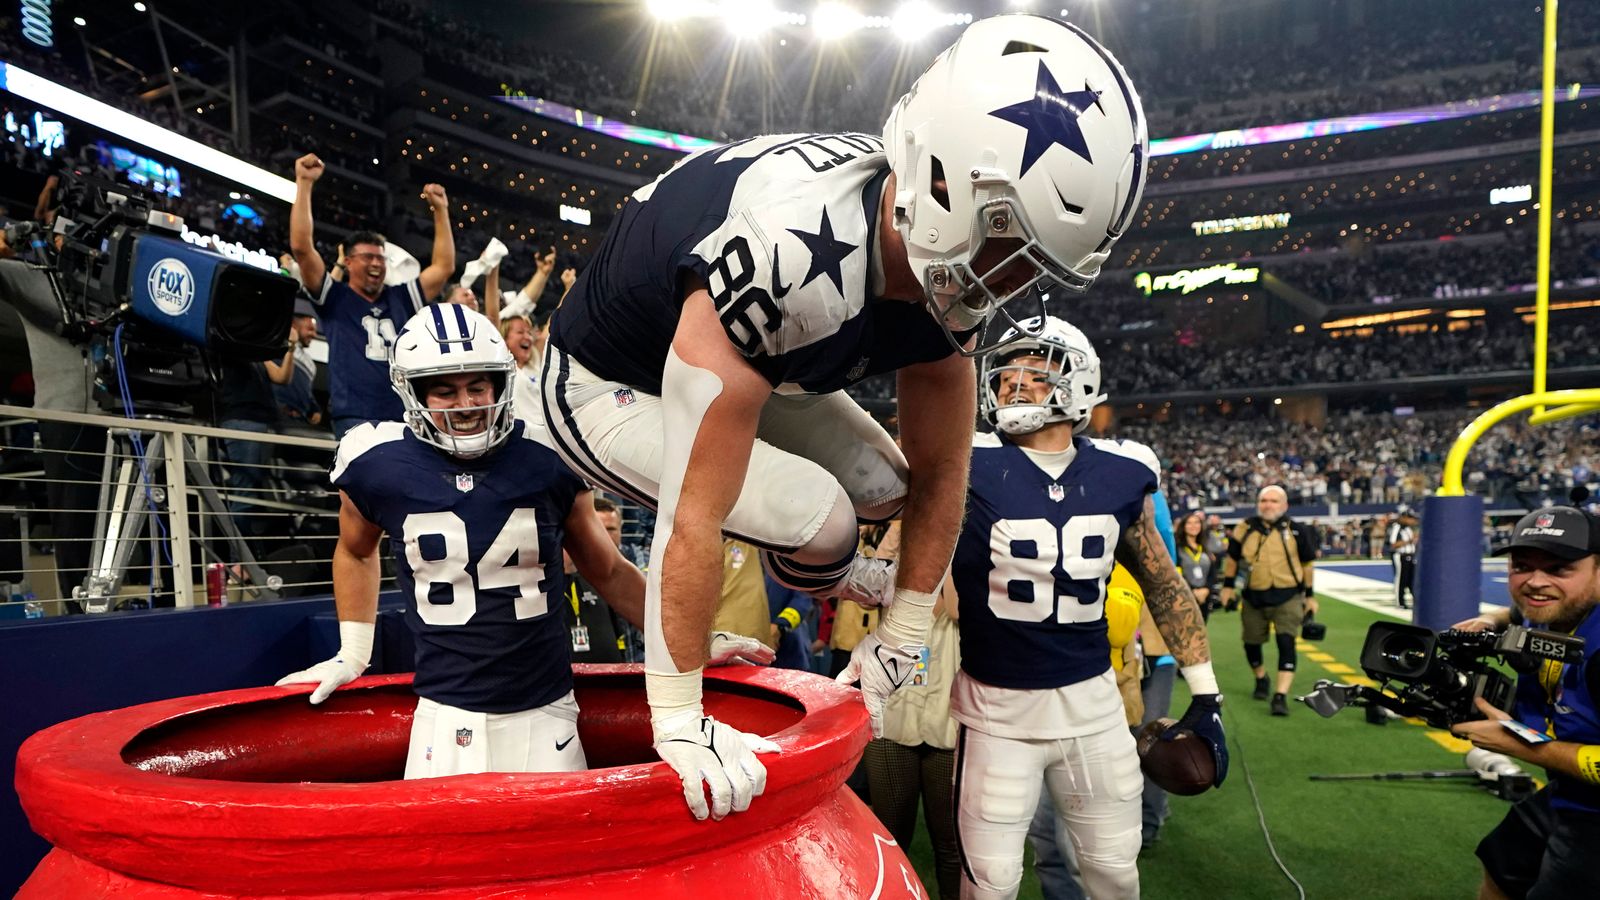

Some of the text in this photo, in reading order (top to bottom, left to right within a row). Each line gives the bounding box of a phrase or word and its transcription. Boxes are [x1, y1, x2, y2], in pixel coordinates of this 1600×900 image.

[158, 267, 185, 297] FOX
[707, 235, 783, 356] 86
[156, 290, 183, 306] SPORTS
[1520, 527, 1566, 537] FILMS
[402, 507, 549, 626] 84
[987, 513, 1121, 625] 89
[1531, 639, 1565, 656] SDS
